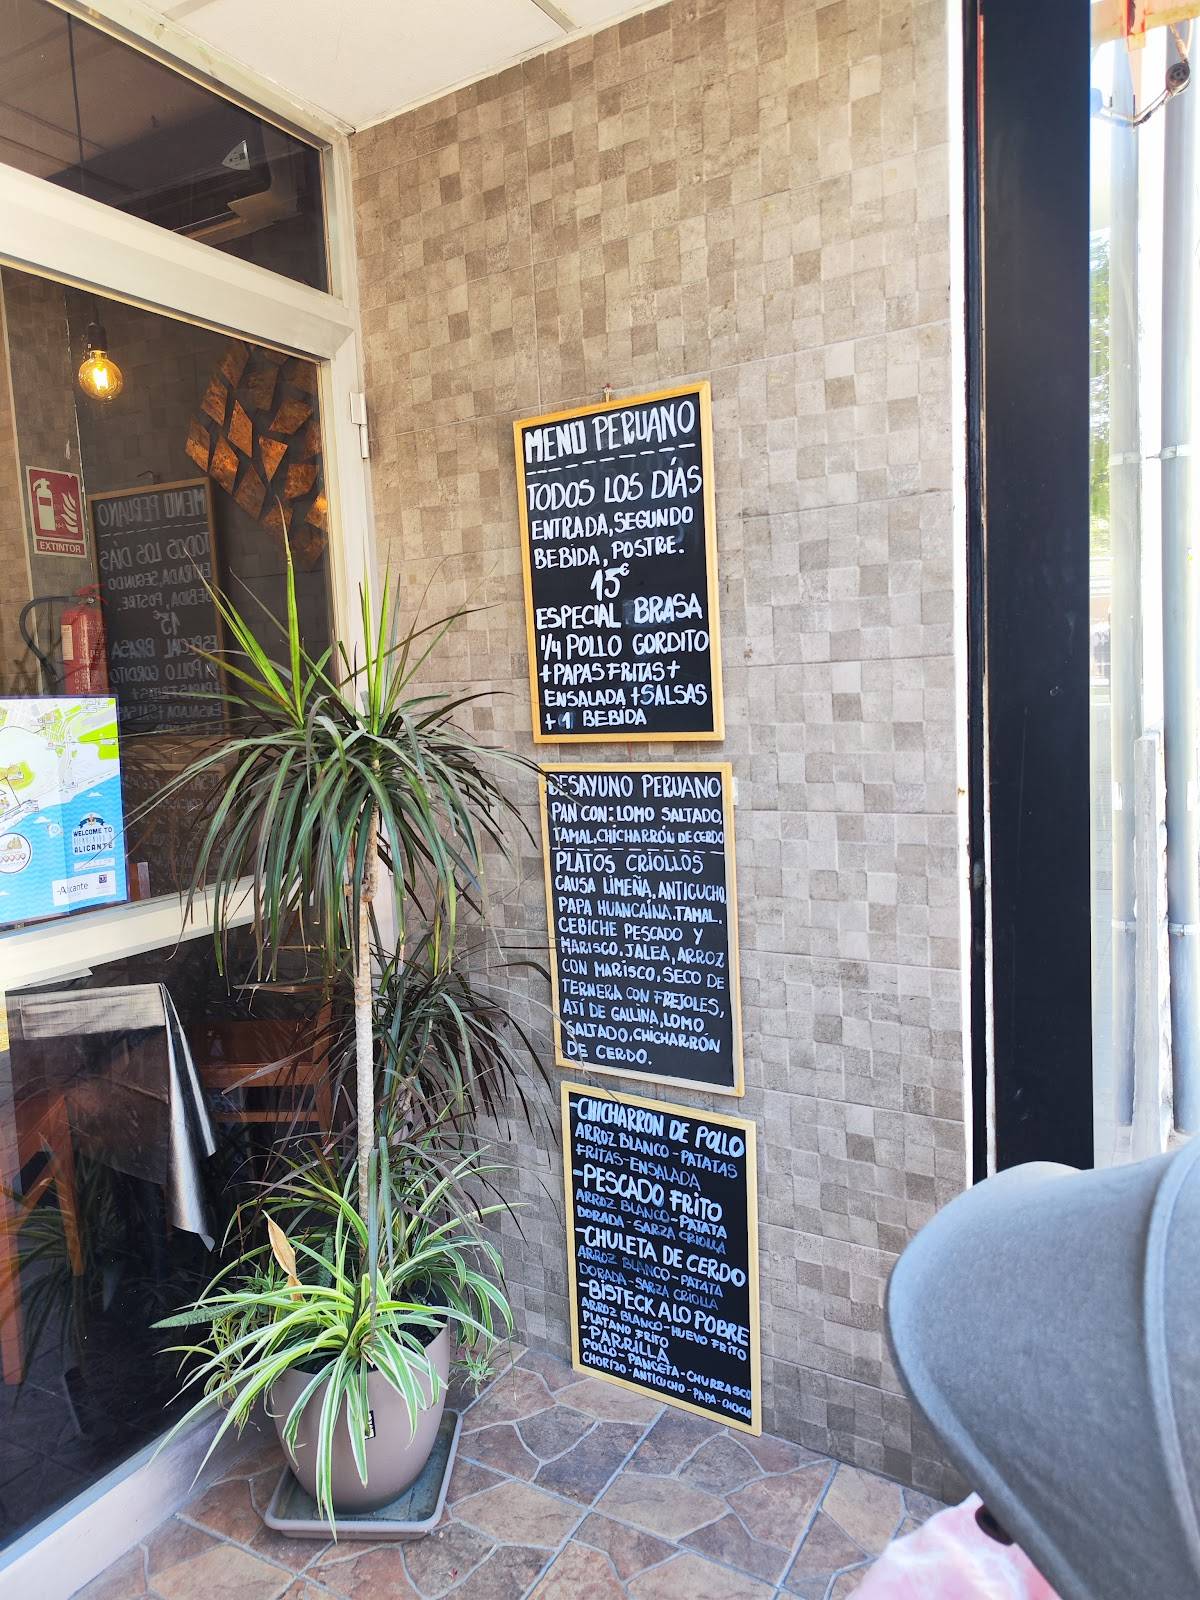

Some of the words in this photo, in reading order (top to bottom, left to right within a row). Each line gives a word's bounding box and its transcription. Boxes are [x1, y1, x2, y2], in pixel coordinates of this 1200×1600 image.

[592, 401, 695, 450] PERUANO
[527, 479, 595, 511] TODOS
[604, 473, 643, 503] LOS
[651, 457, 702, 499] DÍAS
[614, 506, 693, 533] SEGUNDO
[40, 541, 81, 553] EXTINTOR
[534, 544, 608, 569] BEBIDA,
[612, 536, 685, 559] POSTRE.
[536, 602, 621, 630] ESPECIAL
[634, 593, 703, 624] BRASA
[566, 634, 622, 660] POLLO
[632, 629, 709, 655] GORDITO
[544, 688, 626, 707] ENSALADA
[583, 705, 647, 727] BEBIDA
[548, 774, 633, 796] DESAYUNO
[641, 775, 721, 799] PERUANO
[551, 802, 576, 823] PAN
[617, 806, 654, 823] LOMO
[661, 807, 722, 825] SALTADO,
[73, 828, 102, 837] WELCOME
[678, 832, 692, 843] DE
[75, 843, 112, 853] ALICANTE
[556, 852, 615, 873] PLATOS
[626, 852, 704, 874] CRIOLLOS
[555, 876, 595, 893] CAUSA
[559, 897, 592, 916] PAPA
[558, 917, 617, 936] CEBICHE
[624, 923, 682, 942] PESCADO
[625, 944, 675, 965] JALEA,
[677, 947, 725, 968] ARROZ
[562, 959, 587, 975] CON
[663, 967, 701, 985] SECO
[707, 974, 724, 989] DE
[562, 979, 622, 1000] TERNERA
[626, 987, 649, 1002] CON
[589, 1004, 605, 1018] DE
[611, 1004, 663, 1028] GALLINA,
[663, 1013, 704, 1032] LOMO
[567, 1041, 588, 1058] DE
[596, 1045, 652, 1065] CERDO.
[575, 1122, 617, 1147] ARROZ
[619, 1133, 669, 1158] BLANCO
[681, 1151, 737, 1179] PATATAS
[669, 1120, 690, 1143] DE
[695, 1126, 744, 1158] POLLO
[576, 1189, 617, 1209] ARROZ
[621, 1201, 670, 1223] BLANCO
[679, 1215, 727, 1239] PATATA
[577, 1205, 624, 1228] DORADA
[669, 1189, 722, 1222] FRITO
[578, 1245, 618, 1265] ARROZ
[622, 1257, 670, 1282] BLANCO
[681, 1275, 723, 1298] PATATA
[579, 1263, 627, 1286] DORADA
[663, 1245, 683, 1269] DE
[686, 1254, 746, 1287] CERDO
[581, 1296, 618, 1317] ARROZ
[620, 1311, 663, 1332] BLANCO
[671, 1326, 708, 1345] HUEVO
[711, 1338, 747, 1361] FRITO
[583, 1311, 631, 1335] PLATANO
[694, 1310, 749, 1347] POBRE
[583, 1338, 617, 1358] POLLO
[628, 1352, 679, 1378] PANCETA
[693, 1388, 716, 1404] PAPA
